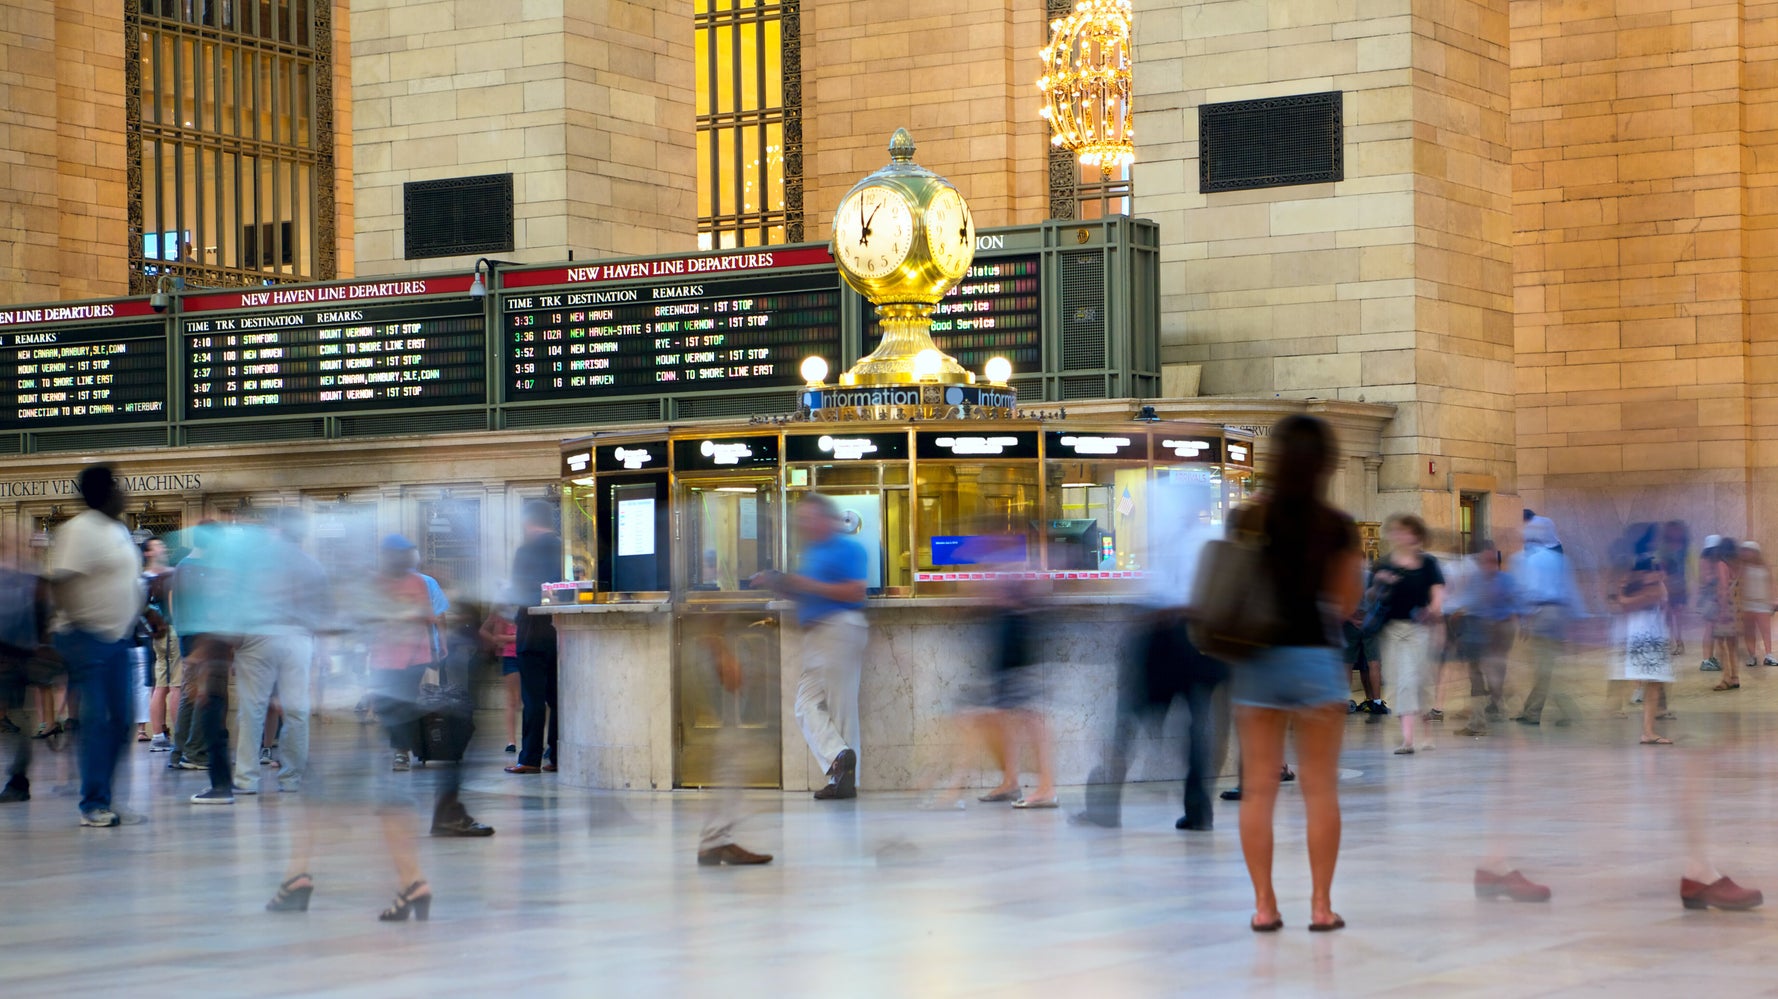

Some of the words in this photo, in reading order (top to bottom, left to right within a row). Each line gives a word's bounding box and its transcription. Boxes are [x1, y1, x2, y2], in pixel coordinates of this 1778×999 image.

[892, 242, 898, 254] 4
[975, 235, 1004, 249] ION
[567, 267, 599, 281] NEW
[603, 263, 649, 279] HAVEN
[653, 260, 684, 275] LINE
[688, 253, 773, 272] DEPARTURES
[854, 257, 860, 268] 7
[868, 259, 875, 272] 6
[881, 255, 888, 267] 5
[241, 292, 270, 306] NEW
[273, 289, 314, 304] HAVEN
[318, 286, 345, 300] LINE
[349, 280, 426, 299] DEPARTURES
[508, 298, 533, 309] TIME
[540, 296, 561, 306] TRK
[568, 290, 637, 305] DESTINATION
[652, 285, 704, 298] REMARKS
[962, 282, 1000, 295] service
[16, 310, 45, 323] LINE
[45, 304, 114, 321] DEPARTURES
[187, 322, 209, 332] TIME
[216, 320, 235, 330] TRK
[241, 315, 303, 329] DESTINATION
[317, 311, 363, 323] REMARKS
[514, 316, 534, 326] 3:33
[552, 314, 561, 323] 19
[570, 312, 584, 322] NEW
[589, 310, 613, 320] HAVEN
[655, 304, 699, 316] GREENWICH
[714, 301, 728, 312] 1ST
[733, 300, 753, 310] STOP
[514, 331, 534, 342] 3:36
[570, 328, 584, 338] NEW
[589, 324, 641, 337] HAVEN-STATE
[646, 324, 651, 333] S
[655, 321, 679, 333] MOUNT
[684, 319, 714, 330] VERNON
[729, 316, 743, 328] 1ST
[748, 315, 768, 326] STOP
[930, 320, 952, 331] Good
[957, 318, 994, 329] Service
[15, 333, 57, 344] REMARKS
[193, 338, 211, 347] 2:10
[243, 333, 278, 345] STAMFORD
[320, 329, 342, 340] MOUNT
[346, 327, 373, 337] VERNON
[386, 325, 399, 335] 1ST
[402, 324, 421, 333] STOP
[18, 350, 30, 360] NEW
[193, 353, 211, 363] 2:34
[243, 350, 256, 360] NEW
[260, 348, 282, 358] HAVEN
[320, 345, 341, 355] CONN.
[346, 343, 356, 353] TO
[359, 342, 382, 352] SHORE
[385, 340, 403, 350] LINE
[407, 339, 426, 349] EAST
[515, 348, 534, 358] 3:52
[548, 346, 561, 355] 104
[570, 344, 585, 354] NEW
[589, 342, 618, 353] CANAAN
[655, 338, 670, 349] RYE
[685, 336, 699, 347] 1ST
[704, 335, 724, 346] STOP
[18, 364, 38, 374] MOUNT
[42, 362, 66, 373] VERNON
[78, 361, 90, 371] 1ST
[93, 360, 110, 370] STOP
[193, 368, 211, 378] 2:37
[228, 367, 236, 376] 19
[243, 364, 278, 375] STAMFORD
[320, 360, 342, 370] MOUNT
[346, 358, 373, 368] VERNON
[387, 356, 399, 366] 1ST
[403, 355, 422, 365] STOP
[553, 362, 562, 371] 19
[570, 359, 609, 370] HARRISON
[656, 354, 680, 365] MOUNT
[685, 351, 714, 363] VERNON
[729, 350, 743, 360] 1ST
[748, 348, 768, 359] STOP
[18, 379, 38, 389] CONN.
[42, 378, 50, 387] TO
[54, 376, 74, 386] SHORE
[77, 376, 94, 385] LINE
[97, 374, 114, 384] EAST
[194, 383, 211, 393] 3:07
[227, 382, 236, 391] 25
[244, 380, 257, 390] NEW
[261, 378, 283, 389] HAVEN
[320, 376, 334, 386] NEW
[516, 379, 534, 390] 4:07
[553, 378, 562, 388] 16
[571, 376, 585, 387] NEW
[590, 375, 614, 385] HAVEN
[656, 371, 679, 382] CONN.
[685, 370, 695, 380] TO
[700, 368, 724, 378] SHORE
[729, 366, 749, 377] LINE
[753, 365, 774, 375] EAST
[18, 394, 38, 404] MOUNT
[42, 392, 66, 402] VERNON
[78, 390, 90, 400] 1ST
[93, 390, 110, 399] STOP
[194, 398, 212, 408] 3:10
[224, 397, 236, 407] 110
[244, 394, 279, 406] STAMFORD
[320, 390, 343, 401] MOUNT
[346, 389, 373, 399] VERNON
[387, 387, 399, 397] 1ST
[403, 386, 422, 396] STOP
[821, 389, 919, 408] Information
[978, 389, 1016, 409] Informa
[18, 407, 58, 418] CONNECTION
[62, 407, 70, 416] TO
[74, 406, 86, 415] NEW
[90, 404, 114, 414] CANAAN
[125, 401, 162, 412] WATERBURY
[0, 481, 48, 496] TICKET
[124, 474, 200, 491] MACHINES
